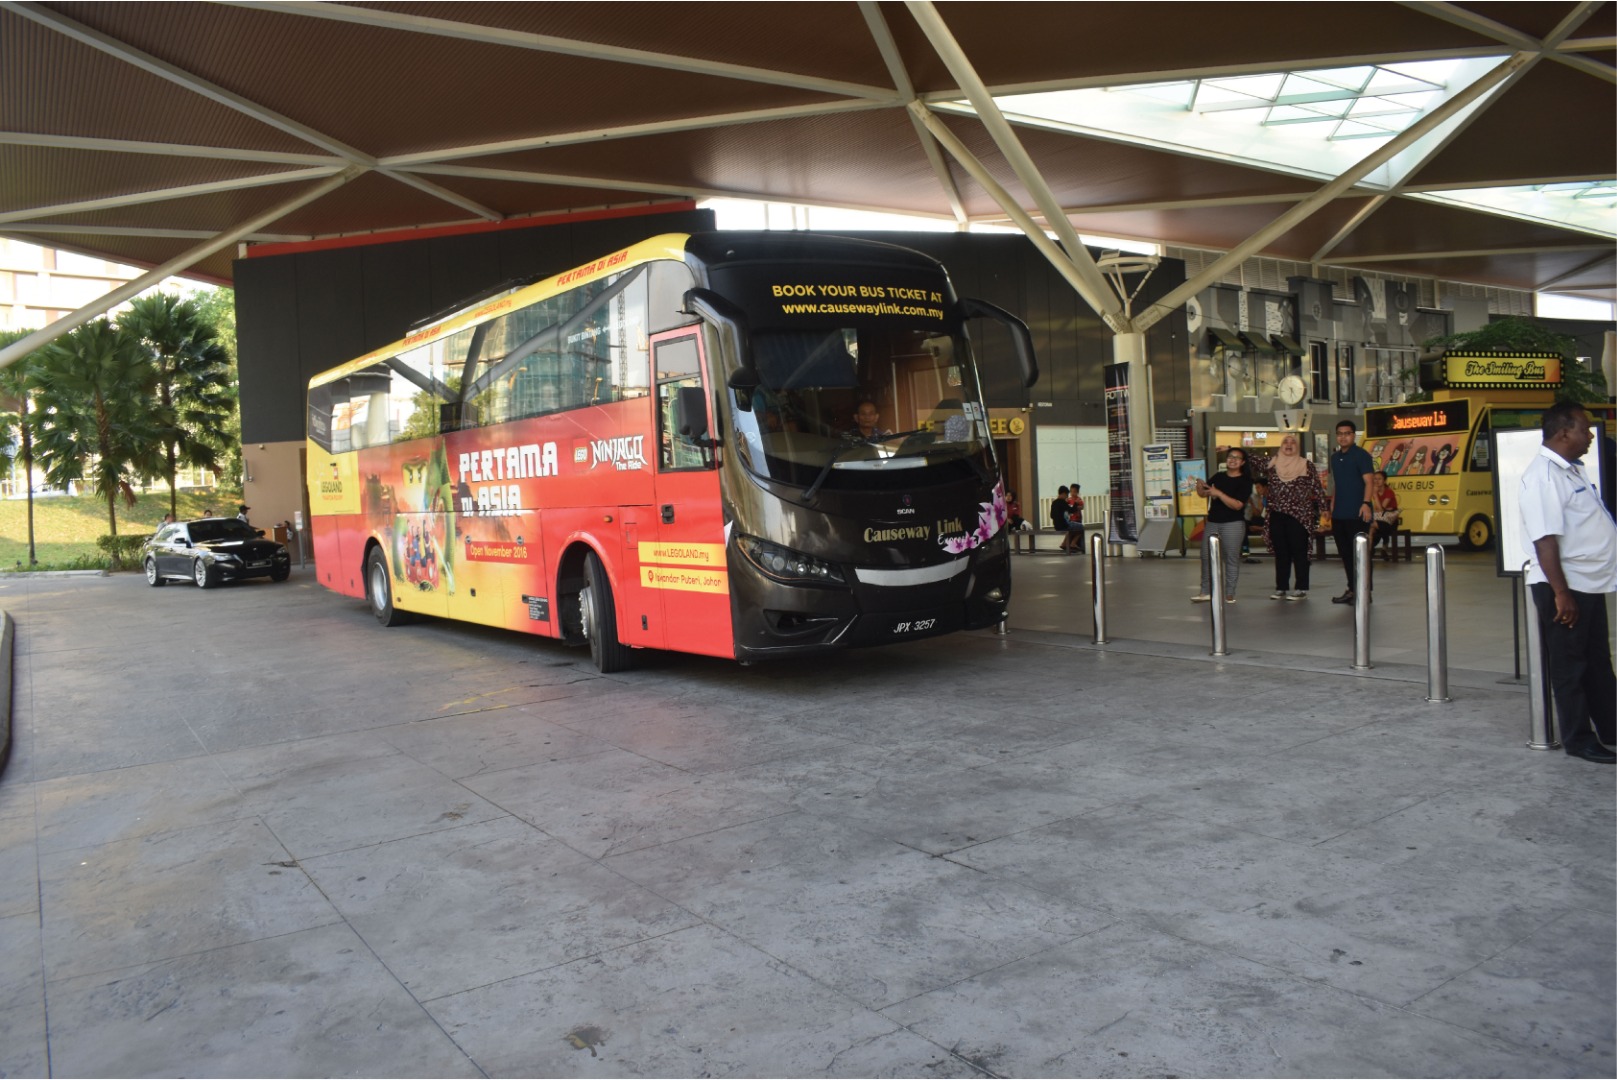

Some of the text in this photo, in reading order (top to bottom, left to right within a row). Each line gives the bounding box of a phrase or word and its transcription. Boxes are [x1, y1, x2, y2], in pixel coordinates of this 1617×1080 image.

[557, 250, 628, 287] PERTAMA DI ASIA
[771, 285, 943, 304] BOOK YOUR BUS TICKET AT
[782, 302, 943, 320] www.causewaylink.com.my
[1465, 360, 1545, 379] The Smiling Bus
[590, 435, 648, 470] NINJAGO
[459, 441, 558, 483] PERTAMA
[616, 460, 642, 471] The Ride
[1416, 480, 1435, 490] BUS
[1466, 488, 1492, 497] Causewa
[461, 484, 521, 517] DI ASIA
[863, 517, 963, 543] Causeway Link
[470, 544, 528, 559] Open November 2016
[653, 548, 709, 562] www.LEGOLAND.my
[655, 572, 680, 583] Iskandar
[893, 618, 936, 634] JPX 3257
